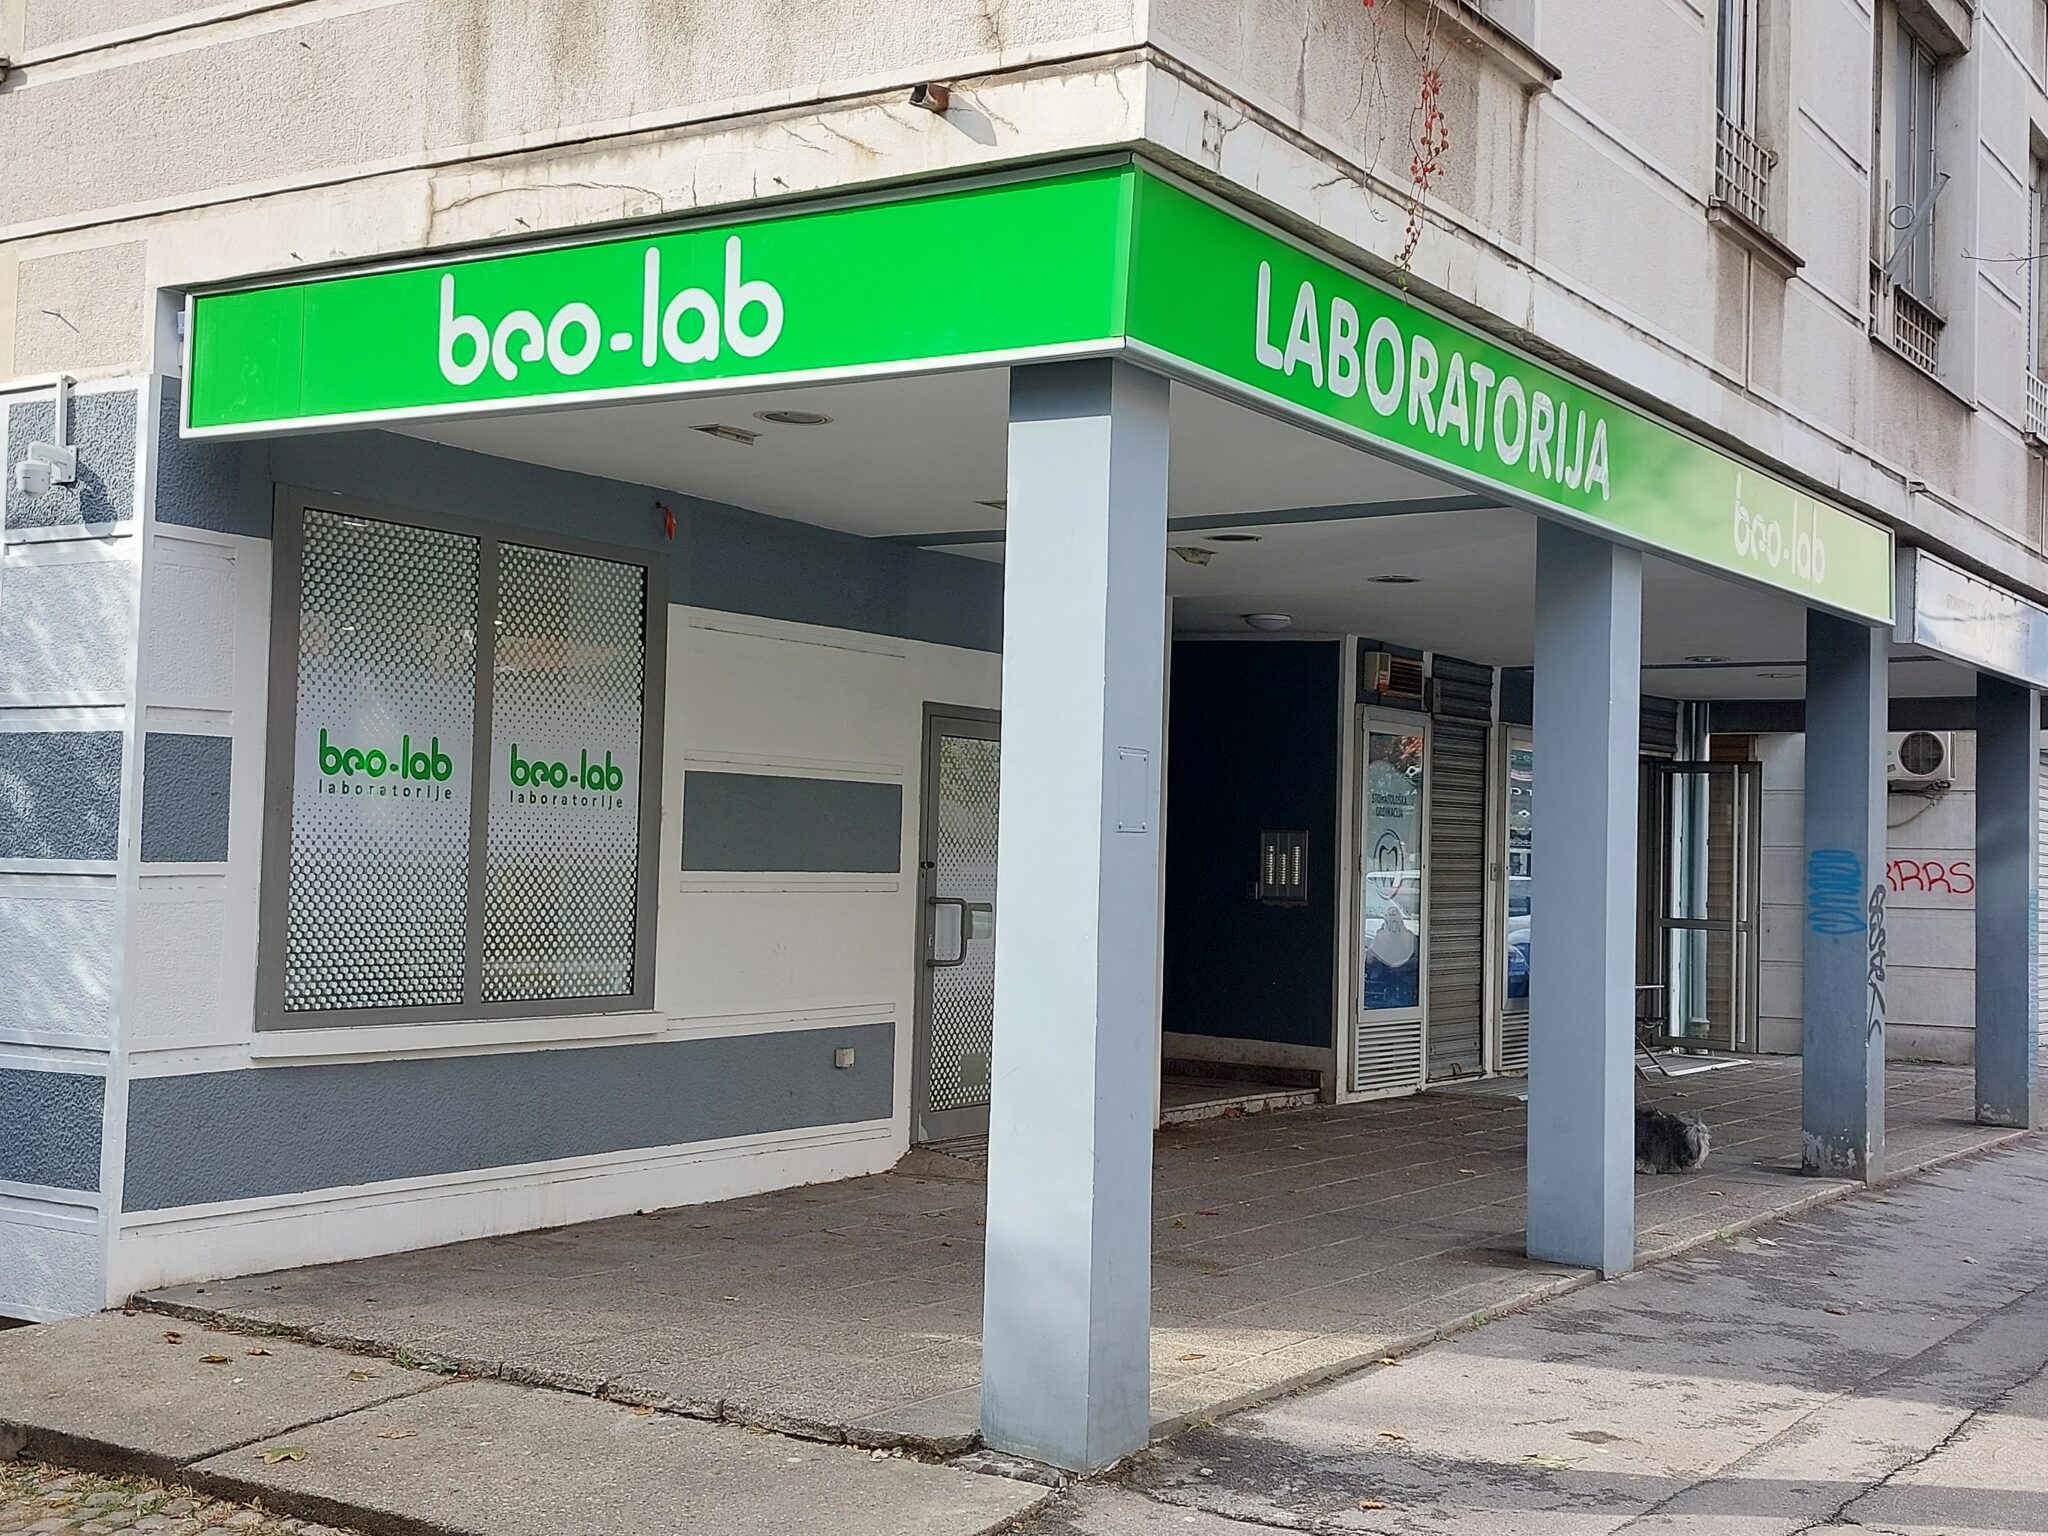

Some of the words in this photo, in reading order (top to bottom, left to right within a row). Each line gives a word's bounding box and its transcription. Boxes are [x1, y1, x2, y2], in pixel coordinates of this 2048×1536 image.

[438, 235, 785, 386] beo-lab
[1255, 260, 1610, 501] LABORATORIJA
[318, 728, 453, 782] beo-lab
[510, 743, 624, 792] beo-lab
[318, 778, 452, 801] laboratorije
[510, 789, 624, 809] laboratorije
